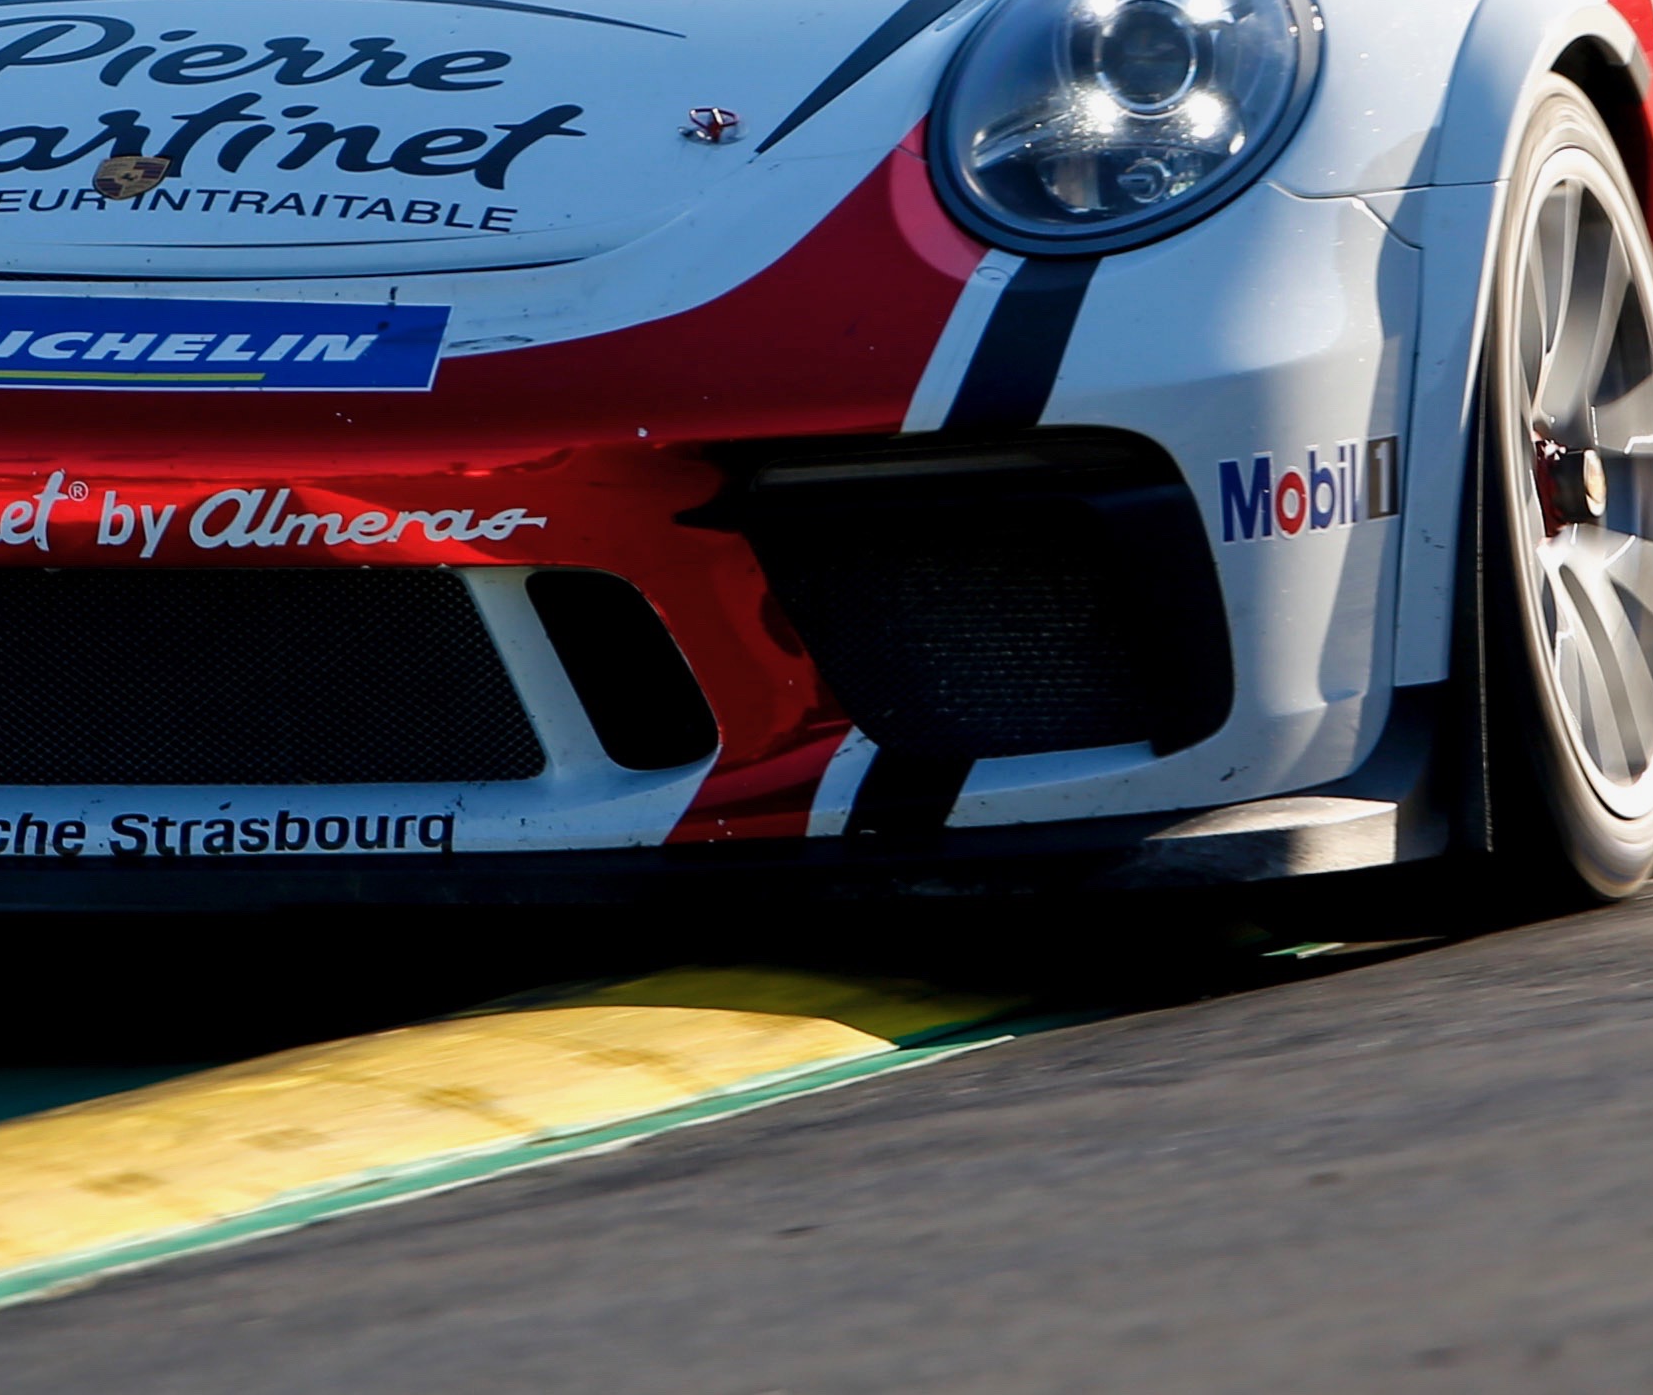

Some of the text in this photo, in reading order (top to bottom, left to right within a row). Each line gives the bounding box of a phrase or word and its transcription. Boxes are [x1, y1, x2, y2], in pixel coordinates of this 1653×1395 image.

[130, 188, 520, 233] INTRAITABLE
[1218, 442, 1358, 544] Mobil
[96, 494, 172, 558] by
